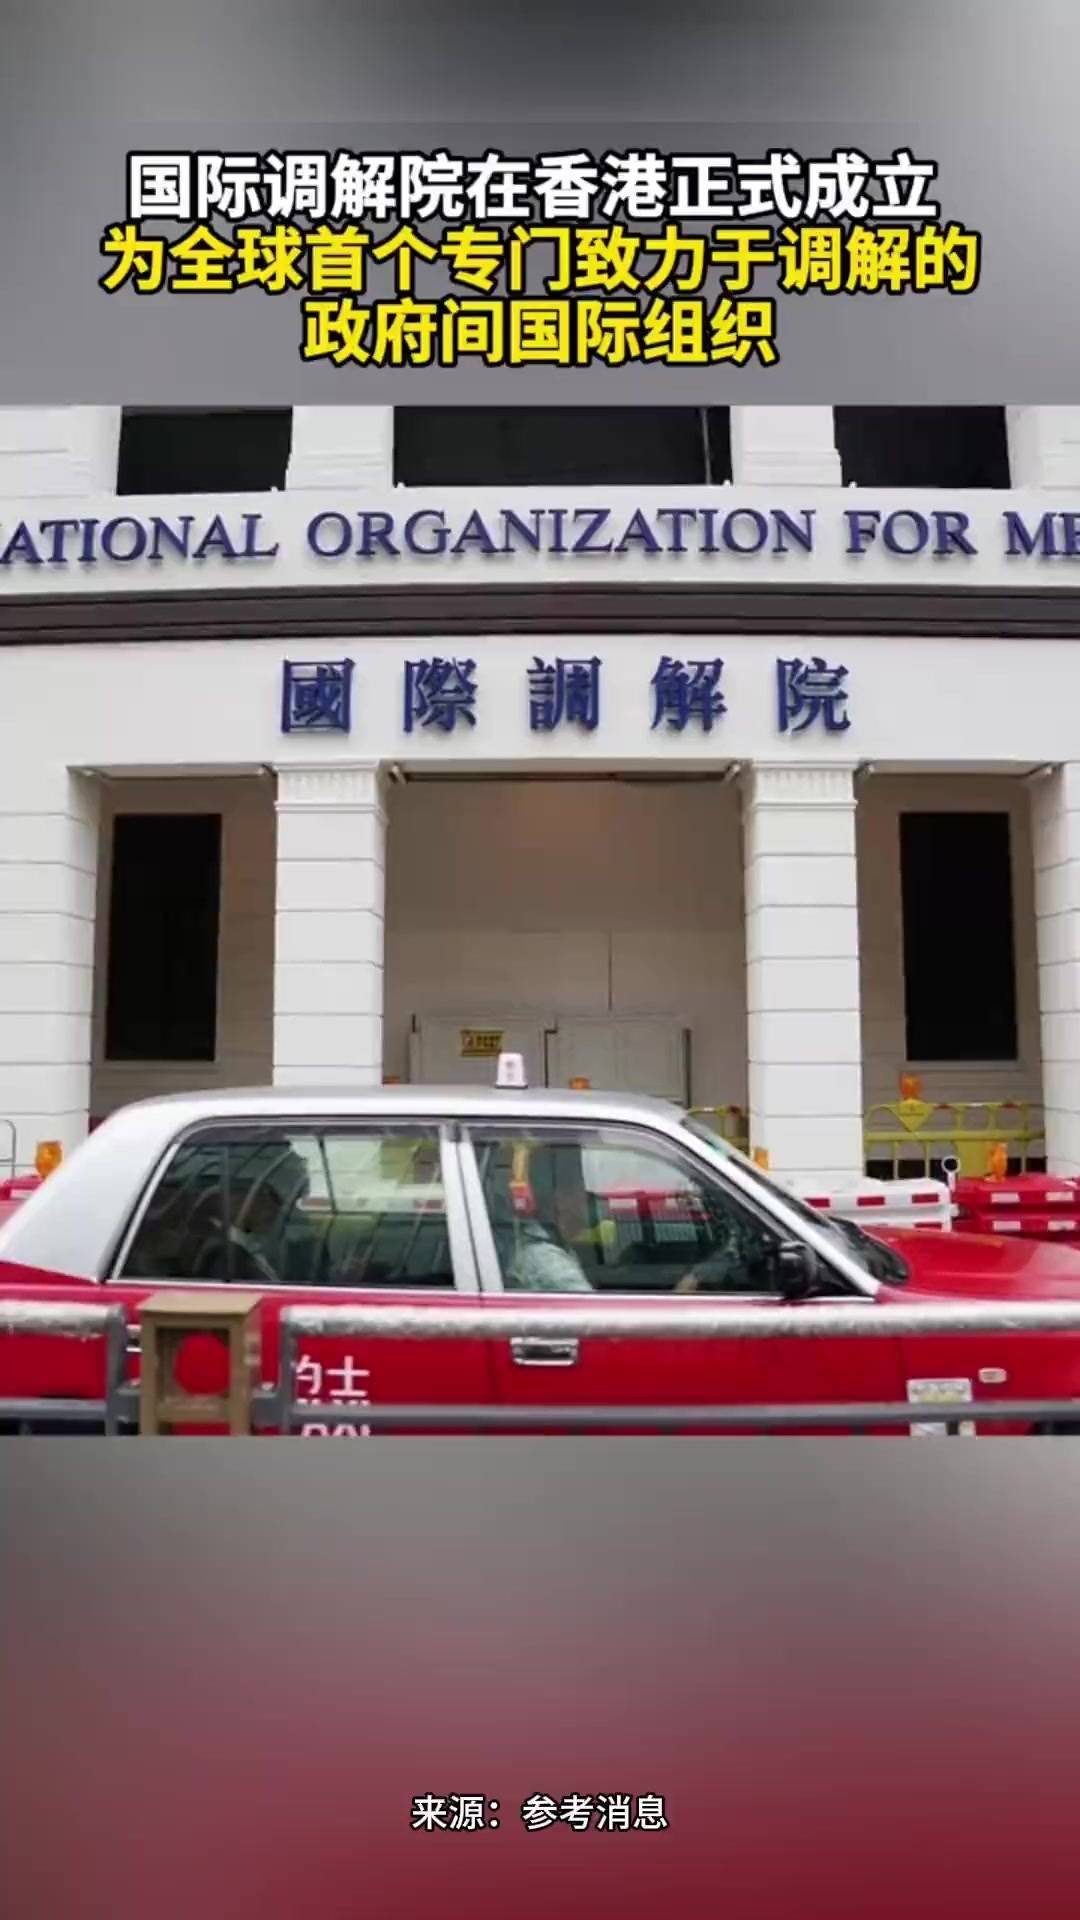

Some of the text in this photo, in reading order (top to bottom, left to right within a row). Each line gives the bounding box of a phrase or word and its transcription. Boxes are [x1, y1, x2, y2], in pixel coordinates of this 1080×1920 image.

[0, 513, 280, 564] ATIONAL
[307, 507, 816, 557] ORGANIZATION
[843, 510, 979, 555] FOR
[281, 656, 852, 733] 國際調解院
